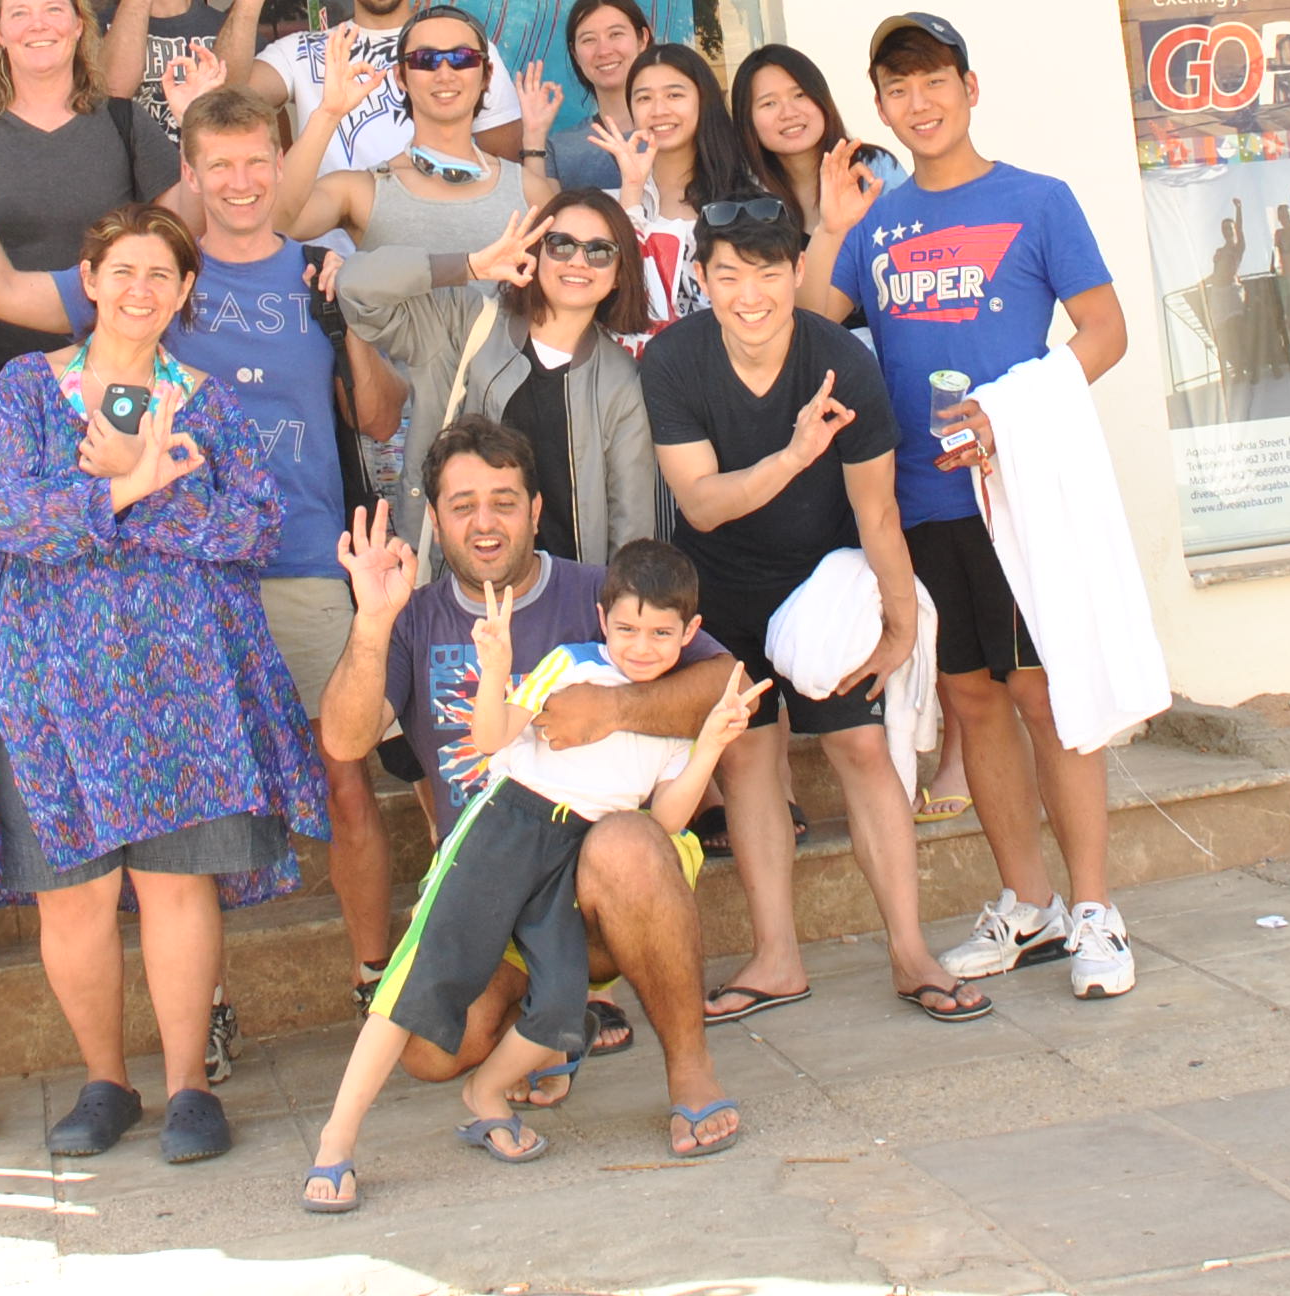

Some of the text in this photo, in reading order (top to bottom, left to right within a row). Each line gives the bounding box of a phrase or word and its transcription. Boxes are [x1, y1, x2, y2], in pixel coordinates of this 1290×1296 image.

[910, 245, 963, 263] DRY
[871, 252, 985, 312] SUPER
[190, 291, 312, 334] FAST
[236, 367, 264, 384] OR
[1259, 437, 1286, 450] Street,
[1269, 450, 1284, 462] 201
